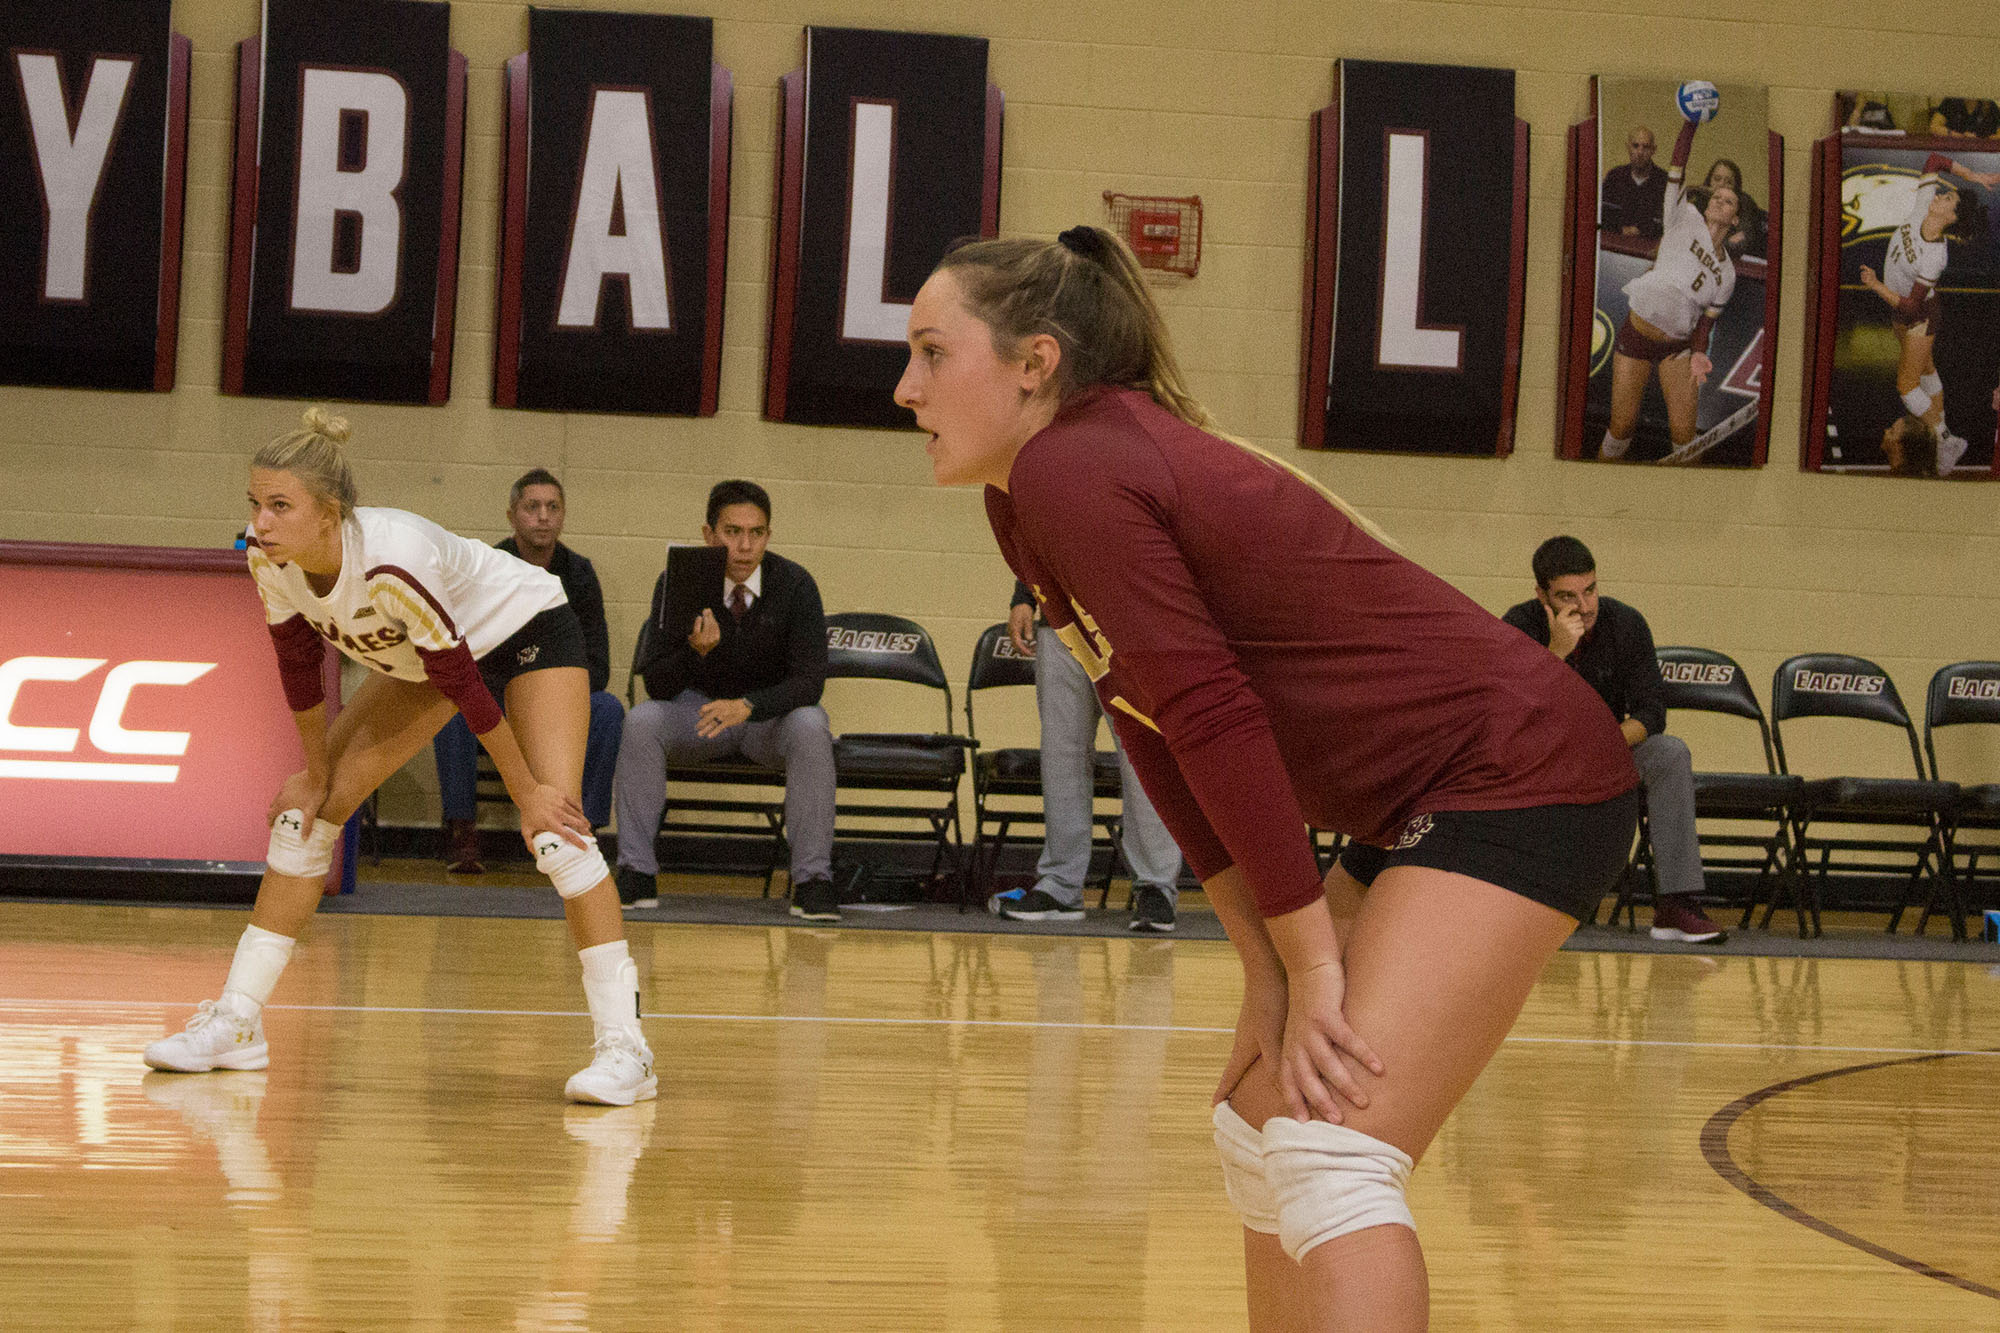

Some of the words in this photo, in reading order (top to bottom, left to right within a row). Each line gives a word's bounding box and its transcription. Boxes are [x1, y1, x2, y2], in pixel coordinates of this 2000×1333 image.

[1689, 239, 1722, 287] EAGLES
[1691, 271, 1706, 292] 6
[827, 627, 920, 653] EAGLES
[1658, 660, 1735, 685] AGLES
[1794, 670, 1886, 695] EAGLES
